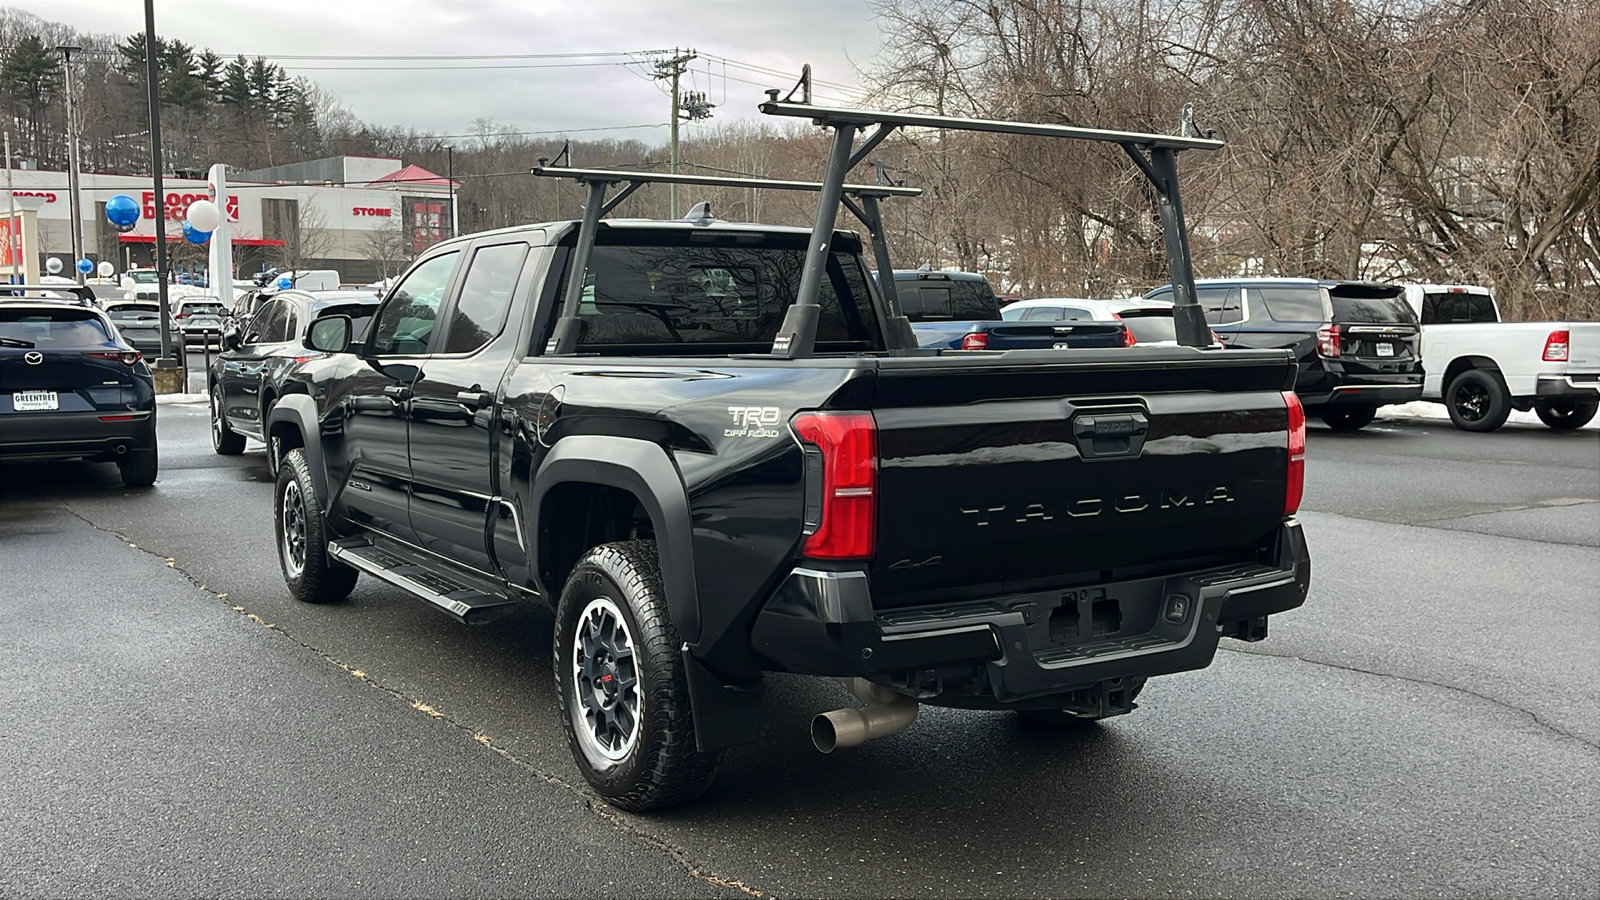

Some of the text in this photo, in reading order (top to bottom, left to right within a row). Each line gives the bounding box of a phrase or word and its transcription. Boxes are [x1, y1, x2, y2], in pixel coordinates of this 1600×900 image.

[142, 192, 209, 206] FOO
[352, 207, 392, 217] STONE
[728, 406, 781, 430] TRD
[1097, 422, 1131, 432] TOYOTA
[724, 429, 779, 438] OFF ROAD
[960, 486, 1235, 526] TACOMA
